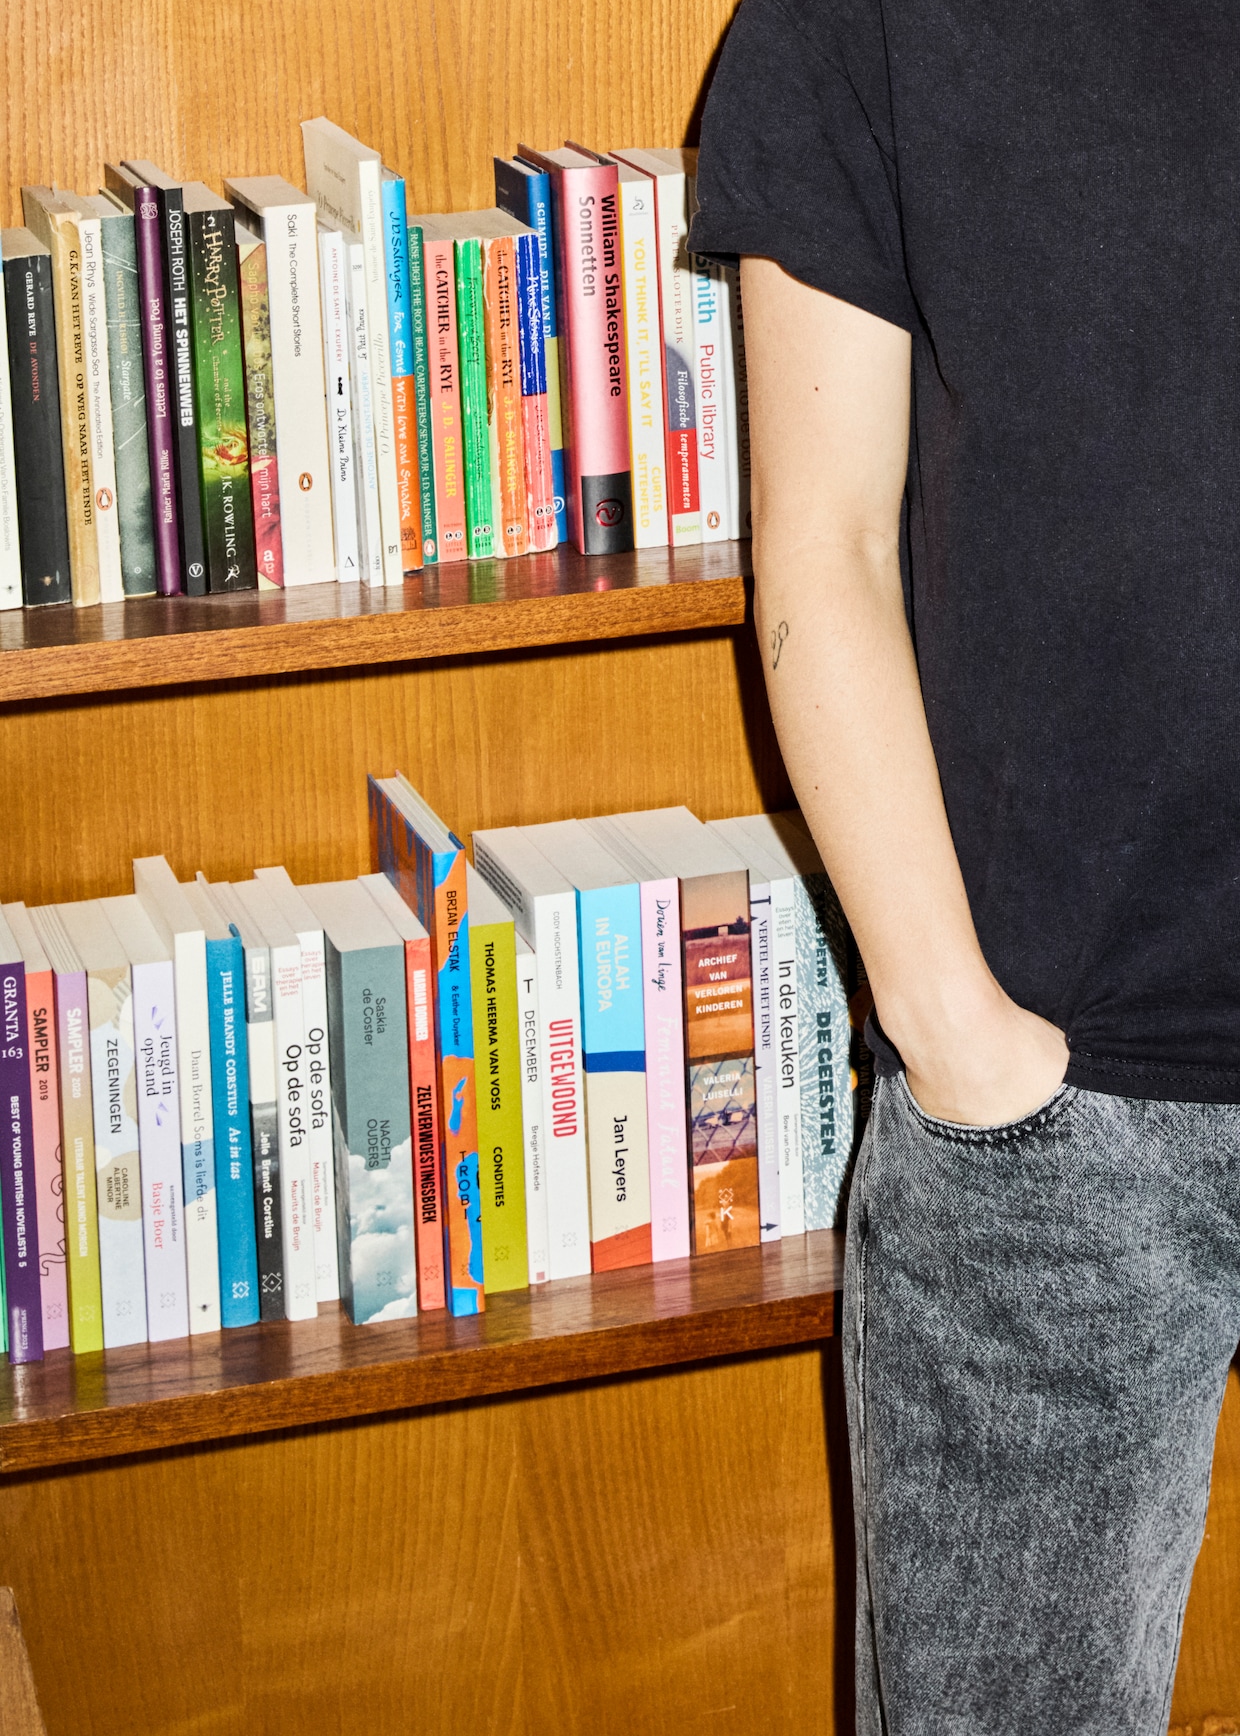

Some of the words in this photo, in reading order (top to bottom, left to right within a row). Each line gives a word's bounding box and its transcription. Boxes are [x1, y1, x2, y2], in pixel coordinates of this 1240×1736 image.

[578, 196, 596, 298] Sonnetten
[601, 194, 617, 268] William
[25, 271, 34, 310] GERARD
[174, 297, 187, 326] HET
[27, 312, 36, 336] REVE
[30, 342, 37, 354] DE
[604, 272, 622, 398] Shakespeare
[31, 358, 40, 401] AVONDEN
[176, 329, 193, 426] SPINNENWEB
[700, 345, 714, 399] Public
[700, 403, 714, 460] library
[778, 960, 794, 978] In
[3, 975, 20, 1043] GRANTA
[779, 982, 794, 1010] de
[1, 1046, 24, 1059] 163
[33, 1007, 49, 1072] SAMPLER
[305, 1027, 324, 1055] Op
[778, 1016, 795, 1089] keuken
[38, 1079, 48, 1100] 2019
[106, 1038, 122, 1134] ZEGENINGEN
[309, 1060, 324, 1084] de
[548, 1018, 577, 1138] UITGEWOOND
[309, 1090, 328, 1130] sofa
[614, 1115, 627, 1143] Jan
[416, 1084, 437, 1224] ZELFVERWOESTINGSBOEK
[612, 1148, 628, 1202] Leyers
